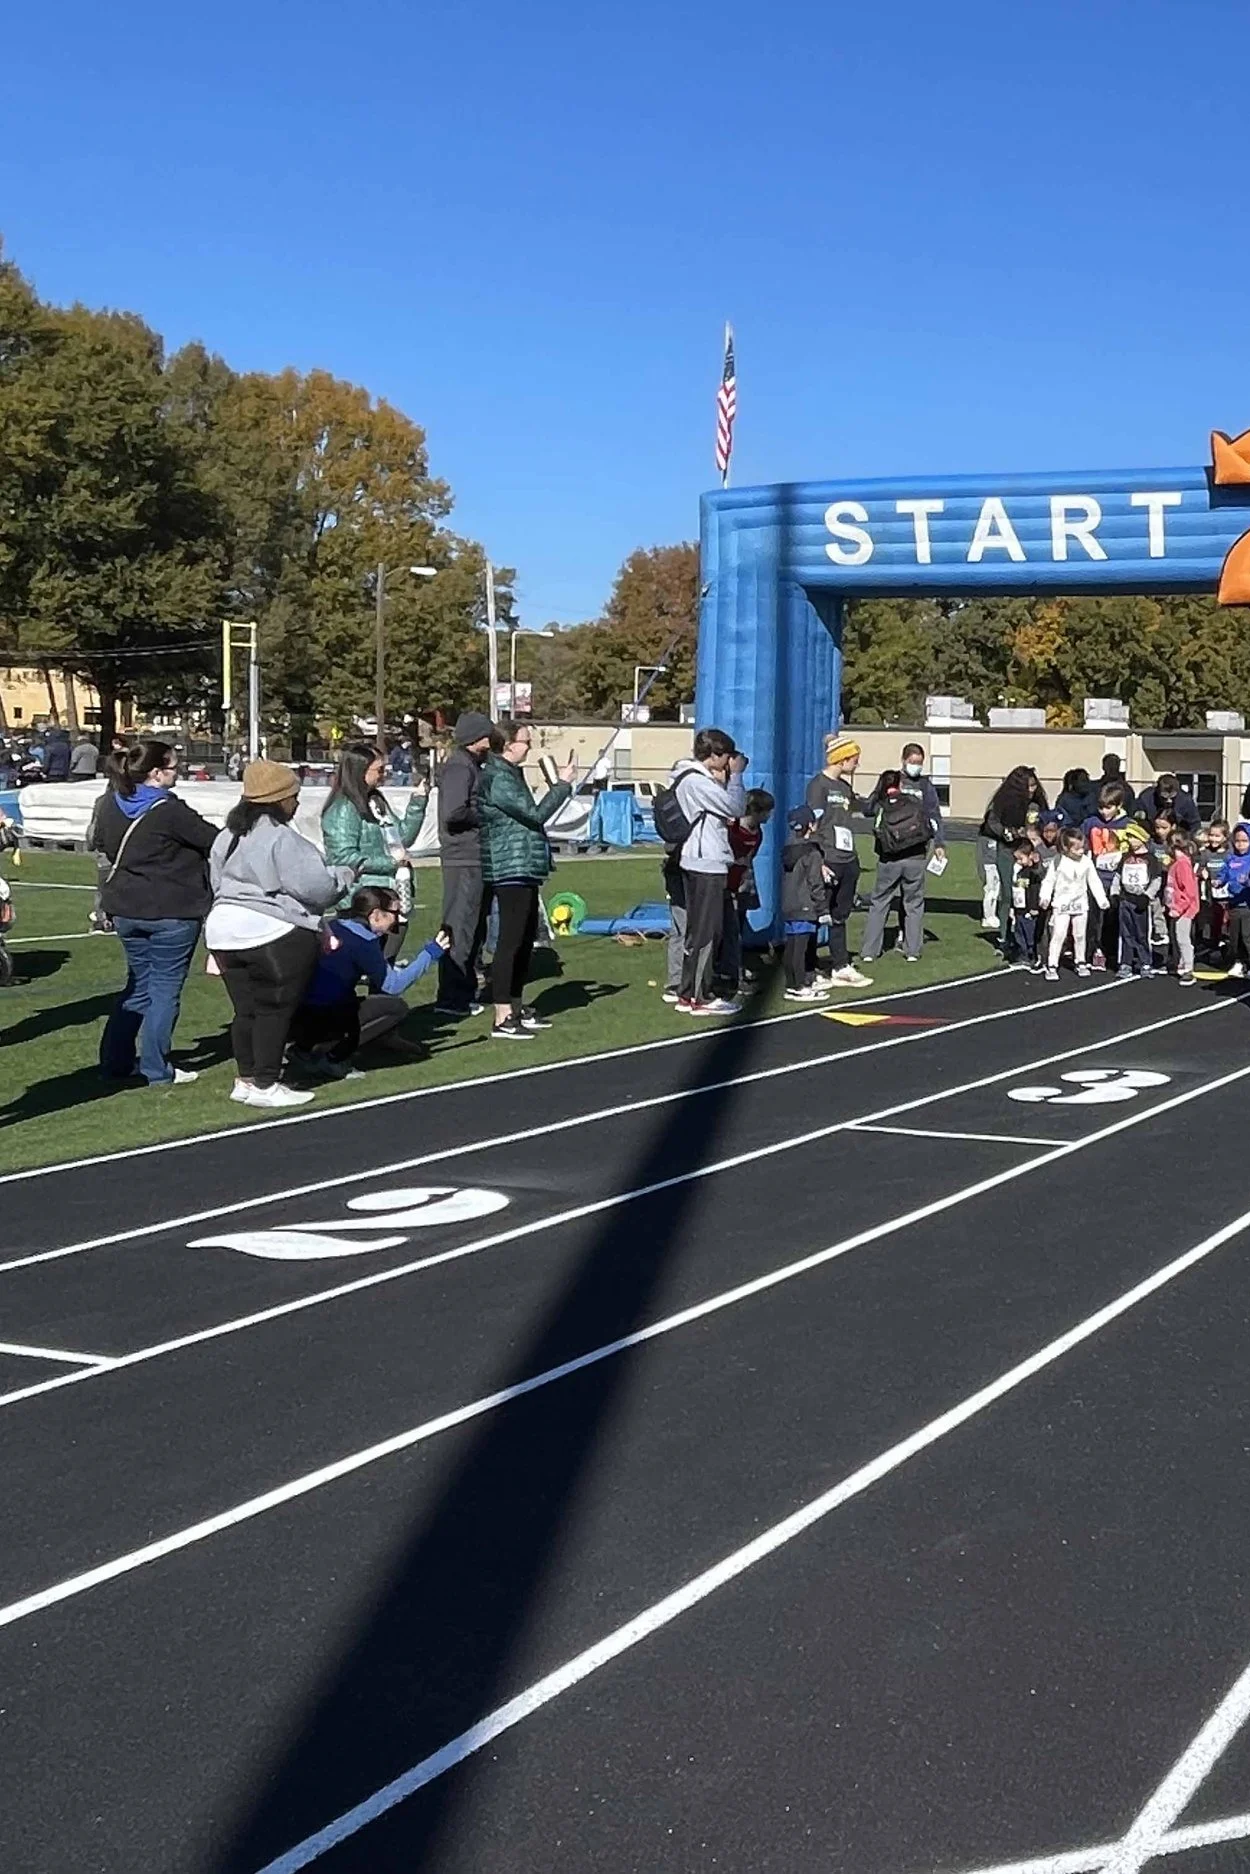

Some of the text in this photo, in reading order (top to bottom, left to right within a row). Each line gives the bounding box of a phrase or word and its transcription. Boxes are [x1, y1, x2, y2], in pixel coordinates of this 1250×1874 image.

[823, 492, 1182, 566] START
[1007, 1069, 1171, 1105] 3
[187, 1186, 511, 1261] 2
